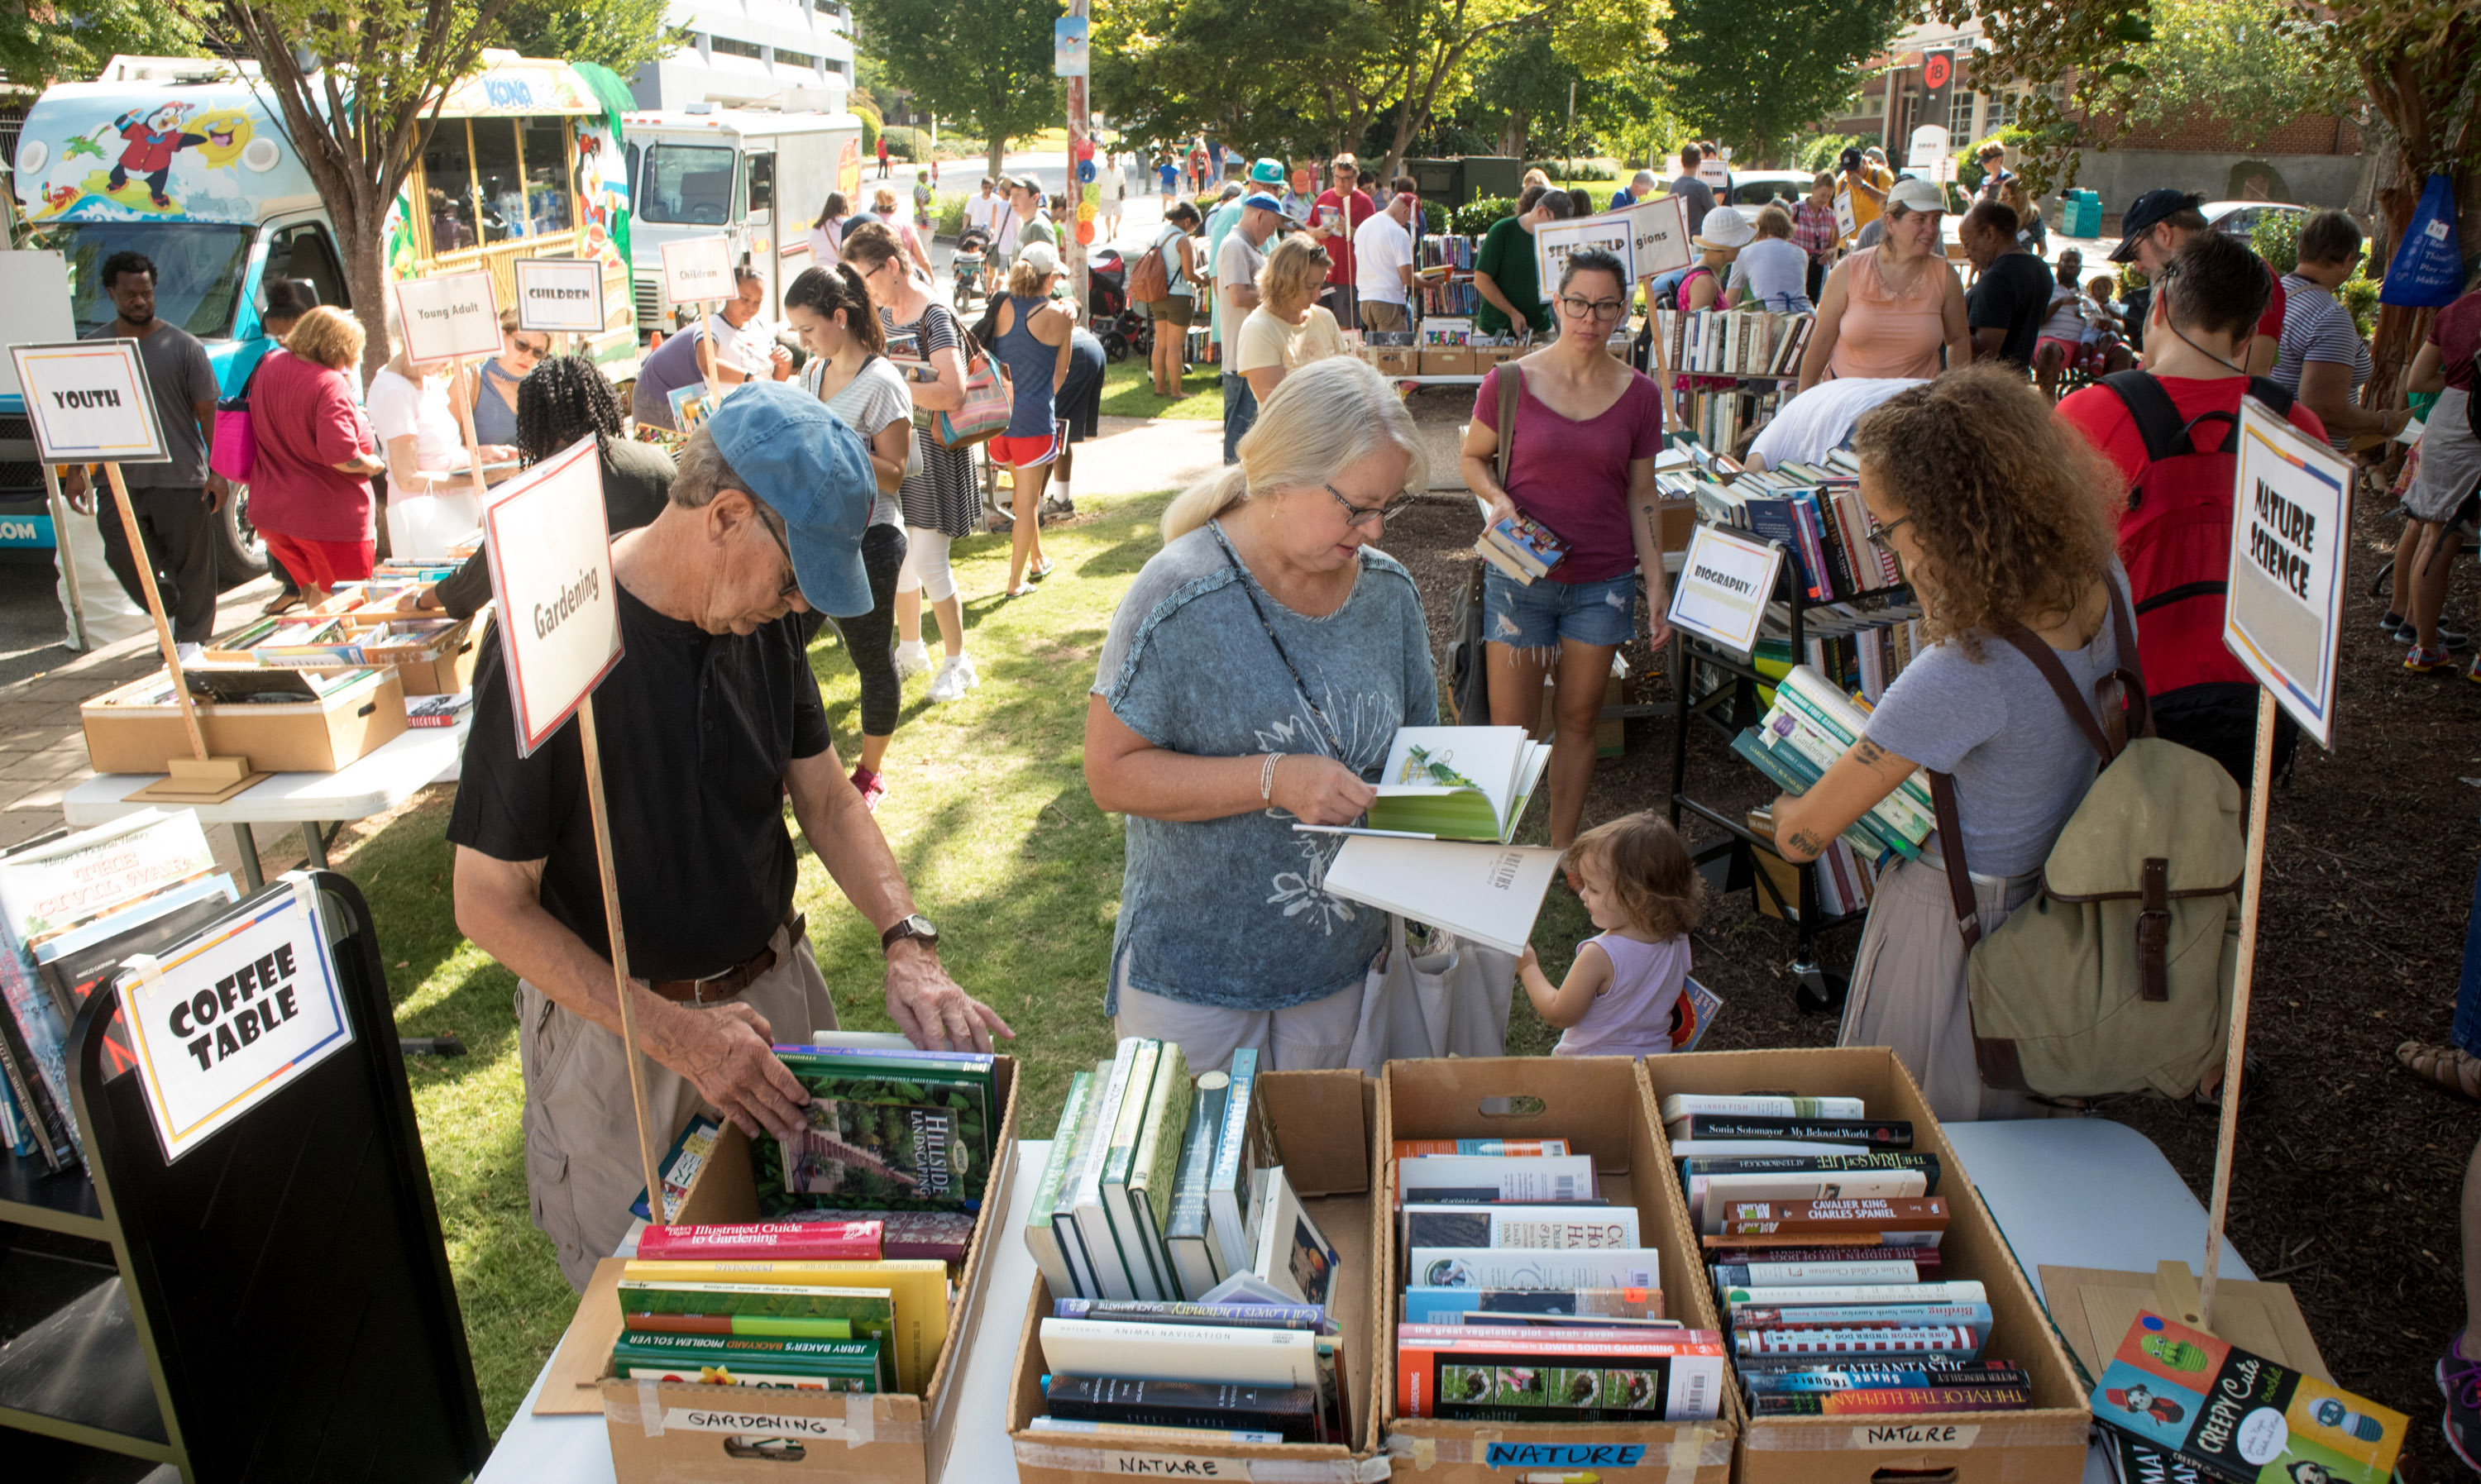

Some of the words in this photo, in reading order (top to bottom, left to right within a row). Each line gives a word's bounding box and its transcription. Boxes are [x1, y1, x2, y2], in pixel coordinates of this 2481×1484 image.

[1931, 64, 1943, 80] 18
[482, 77, 533, 108] KONA
[1637, 231, 1667, 249] gions
[680, 270, 717, 280] Children
[529, 289, 590, 300] CHILDREN
[418, 308, 449, 320] Young
[452, 303, 479, 315] Adult
[1427, 331, 1446, 345] THE
[1447, 331, 1470, 346] ART
[53, 388, 121, 410] YOUTH
[1819, 490, 1831, 513] CALL
[1825, 513, 1834, 527] ME
[2256, 477, 2316, 553] NATURE
[0, 522, 36, 540] OM
[1829, 527, 1840, 545] TED
[2250, 521, 2310, 601] SCIENCE
[1695, 564, 1751, 596] BIOGRAPHY
[534, 565, 600, 640] Gardening
[1787, 689, 1810, 710] SQUARE
[1807, 705, 1824, 721] FOOT
[1821, 716, 1853, 745] GARDENING
[1793, 730, 1828, 765] Gardening
[1748, 744, 1780, 771] GARDENING
[1778, 746, 1795, 761] SANDRA
[1862, 812, 1886, 833] ARDENING
[41, 847, 79, 868] Harper's
[81, 838, 117, 857] Pictorial
[118, 829, 151, 847] History
[74, 852, 139, 883] THE
[1494, 852, 1523, 890] WREATHS
[34, 880, 120, 919] CIVIL
[124, 857, 193, 887] WAR
[76, 966, 94, 980] MARCO
[170, 942, 297, 1038] COFFEE
[188, 984, 299, 1073] TABLE
[777, 1053, 817, 1062] PERENNIALS
[1728, 1103, 1749, 1111] FISH
[1709, 1124, 1734, 1135] Sonia
[1737, 1125, 1784, 1137] Sotomayor
[1790, 1127, 1804, 1138] My
[1806, 1128, 1840, 1138] Beloved
[1841, 1129, 1869, 1138] World
[1217, 1104, 1244, 1176] LANDSCAPING
[911, 1110, 932, 1196] LANDSCAPING
[925, 1114, 950, 1195] HILLSIDE
[956, 1143, 966, 1171] Sunset
[1740, 1159, 1805, 1168] ATTENBOROUGH
[1815, 1154, 1848, 1171] LIFE
[1859, 1152, 1905, 1171] TRIALS
[1902, 1156, 1926, 1166] THE
[1812, 1200, 1858, 1210] CAVALIER
[1862, 1200, 1887, 1209] KING
[1809, 1210, 1853, 1219] CHARLES
[1855, 1209, 1897, 1219] SPANIEL
[664, 1224, 692, 1233] Reader's
[695, 1224, 760, 1236] Illustrated
[762, 1223, 802, 1233] Guide
[692, 1234, 706, 1245] to
[707, 1233, 777, 1246] Gardening
[1770, 1252, 1801, 1262] DOGS
[1804, 1252, 1819, 1261] OF
[1820, 1251, 1842, 1261] LIFE
[1846, 1250, 1892, 1261] HIDDEN
[1895, 1249, 1919, 1260] THE
[715, 1263, 773, 1273] PERENNIALS
[1809, 1267, 1848, 1276] Christian
[1851, 1266, 1878, 1276] Called
[1881, 1266, 1902, 1275] Lion
[703, 1283, 734, 1291] gardens
[736, 1283, 761, 1291] shade
[762, 1284, 808, 1293] step-by-step
[1097, 1302, 1134, 1311] McHATTIE
[1136, 1304, 1164, 1312] GRACE
[1171, 1302, 1240, 1319] Dictionary
[1244, 1307, 1289, 1319] Lovers
[1928, 1305, 1973, 1317] Birding
[1292, 1307, 1318, 1325] Cat
[1820, 1310, 1838, 1318] Philip
[1114, 1327, 1157, 1337] ANIMAL
[1160, 1329, 1231, 1340] NAVIGATION
[1415, 1326, 1432, 1334] the
[1435, 1327, 1462, 1336] great
[1465, 1328, 1518, 1338] vegetable
[1521, 1329, 1542, 1338] plot
[1549, 1329, 1580, 1338] sarah
[1834, 1333, 1855, 1341] DOG
[1857, 1332, 1888, 1340] UNDER
[1891, 1331, 1924, 1340] NATION
[1927, 1331, 1948, 1339] ONE
[629, 1334, 673, 1347] SOLVER
[676, 1337, 724, 1349] PROBLEM
[726, 1339, 783, 1351] BACKYARD
[785, 1341, 831, 1353] BAKER'S
[833, 1343, 867, 1354] JERRY
[1539, 1343, 1574, 1352] LOWER
[1577, 1343, 1611, 1352] SOUTH
[1613, 1344, 1675, 1353] GARDENING
[1793, 1375, 1848, 1387] TROUBLE
[1852, 1372, 1900, 1385] SHARK
[1938, 1372, 1985, 1383] BENCHLEY
[1987, 1372, 2018, 1381] PETER
[2222, 1358, 2260, 1399] Cute
[2260, 1367, 2283, 1403] crochet
[1411, 1372, 1421, 1412] GARDENING
[1908, 1391, 1939, 1404] THE
[1941, 1390, 1959, 1403] OF
[1961, 1389, 1994, 1404] EYE
[1995, 1388, 2026, 1404] THE
[1819, 1391, 1904, 1407] ELEPHANT
[689, 1411, 828, 1434] GARDENING
[2197, 1396, 2243, 1453] CREEPY
[1869, 1426, 1956, 1443] NATURE
[1492, 1444, 1638, 1464] NATURE
[2173, 1451, 2203, 1470] CREEPY
[1120, 1457, 1218, 1476] NATURE
